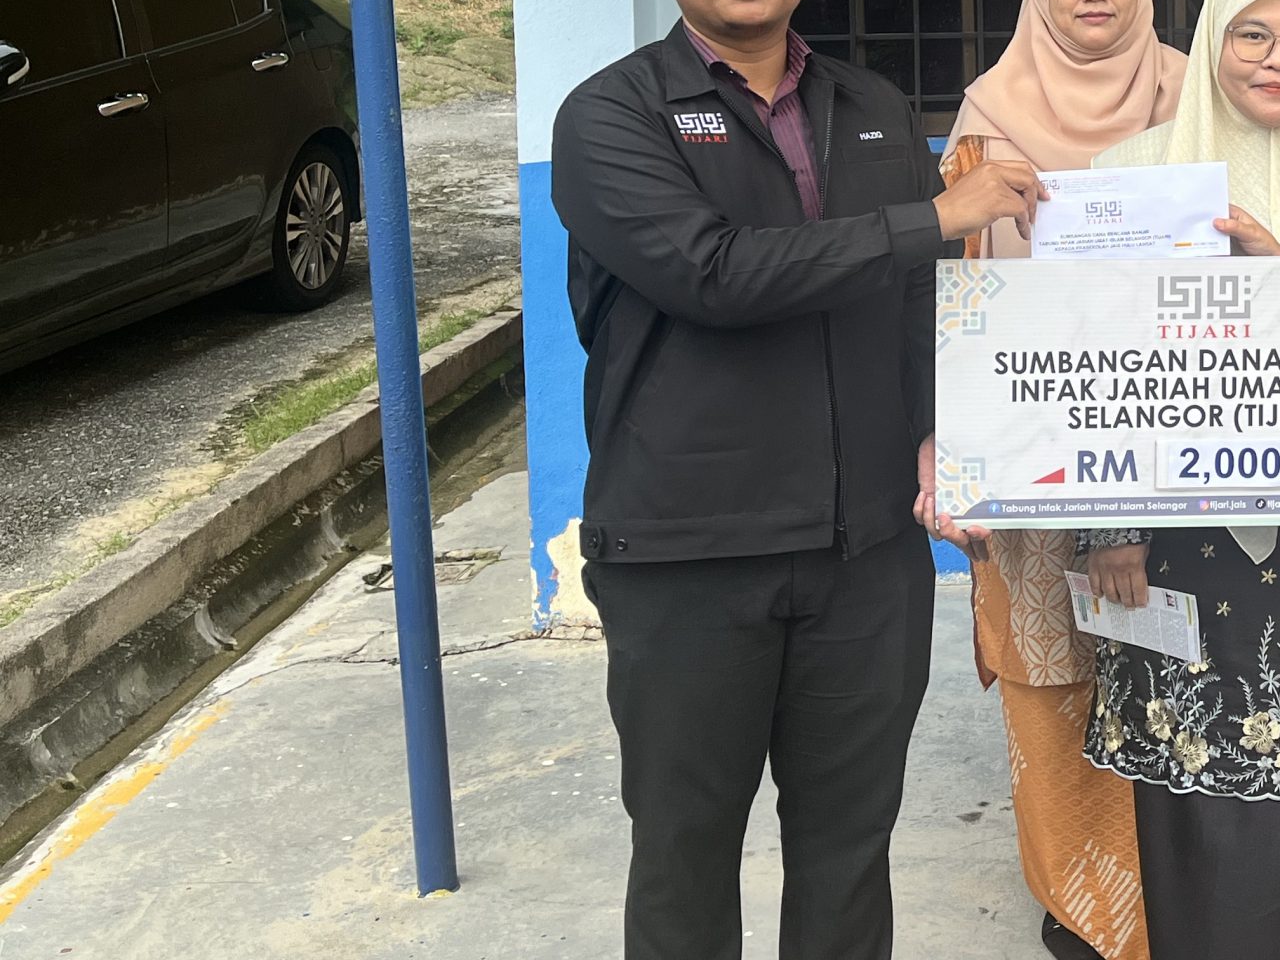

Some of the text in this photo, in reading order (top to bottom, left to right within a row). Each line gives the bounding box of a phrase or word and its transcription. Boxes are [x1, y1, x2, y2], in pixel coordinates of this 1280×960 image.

[682, 134, 728, 143] TIJARI
[859, 131, 883, 140] HAZIQ
[1157, 324, 1251, 339] TIJARI
[994, 349, 1187, 375] SUMBANGAN
[1011, 378, 1097, 402] INFAK
[1106, 377, 1209, 401] JARIAH
[1068, 404, 1223, 429] SELANGOR
[1077, 449, 1138, 483] RM
[1002, 502, 1187, 514] Tabung Infak Jariah Umat Islam Selangor
